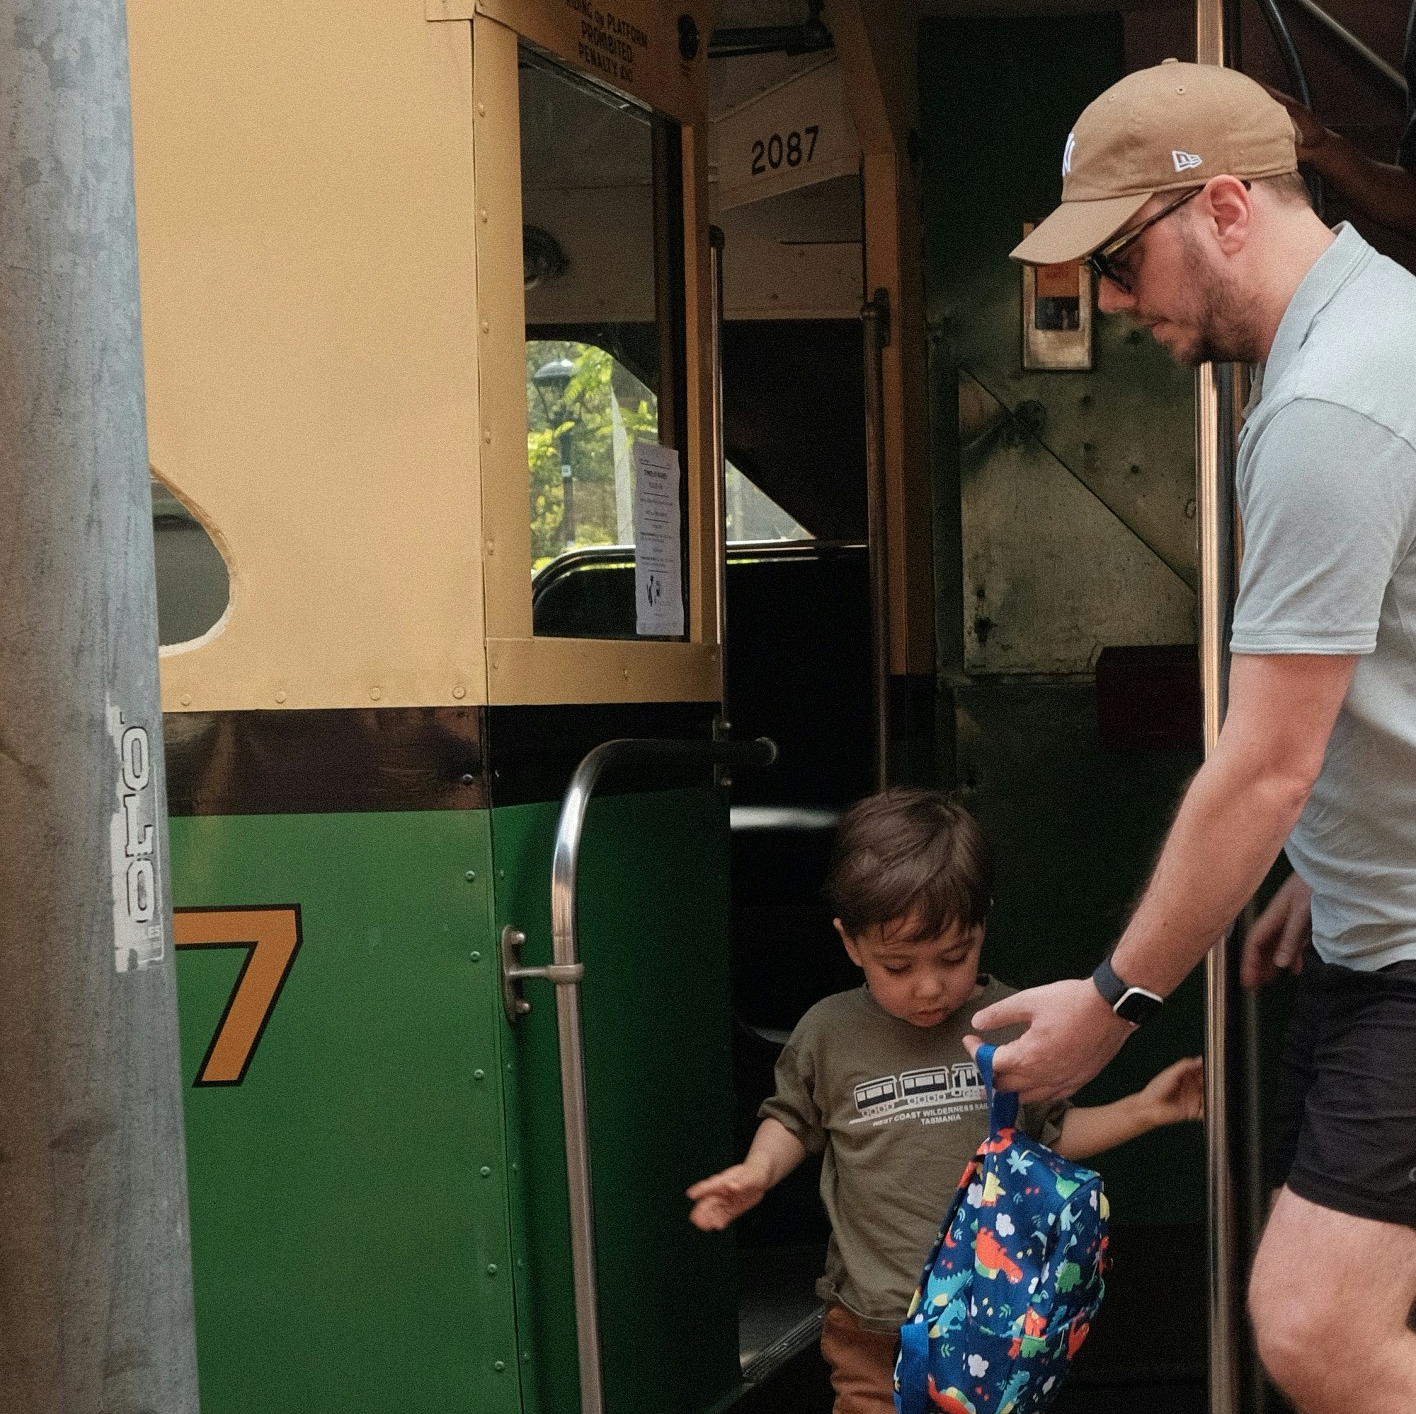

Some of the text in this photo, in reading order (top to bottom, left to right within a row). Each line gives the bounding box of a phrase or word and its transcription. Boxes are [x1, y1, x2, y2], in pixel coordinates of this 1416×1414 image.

[581, 19, 633, 64] PROHIBITED
[607, 12, 648, 49] PLATFORM
[577, 40, 618, 77] PENALTY
[751, 125, 819, 175] 2087
[173, 902, 304, 1088] 7
[873, 1116, 893, 1127] WEST
[894, 1110, 921, 1122] COAST
[922, 1104, 974, 1118] WILDERNESS
[920, 1113, 962, 1126] TASMANIA
